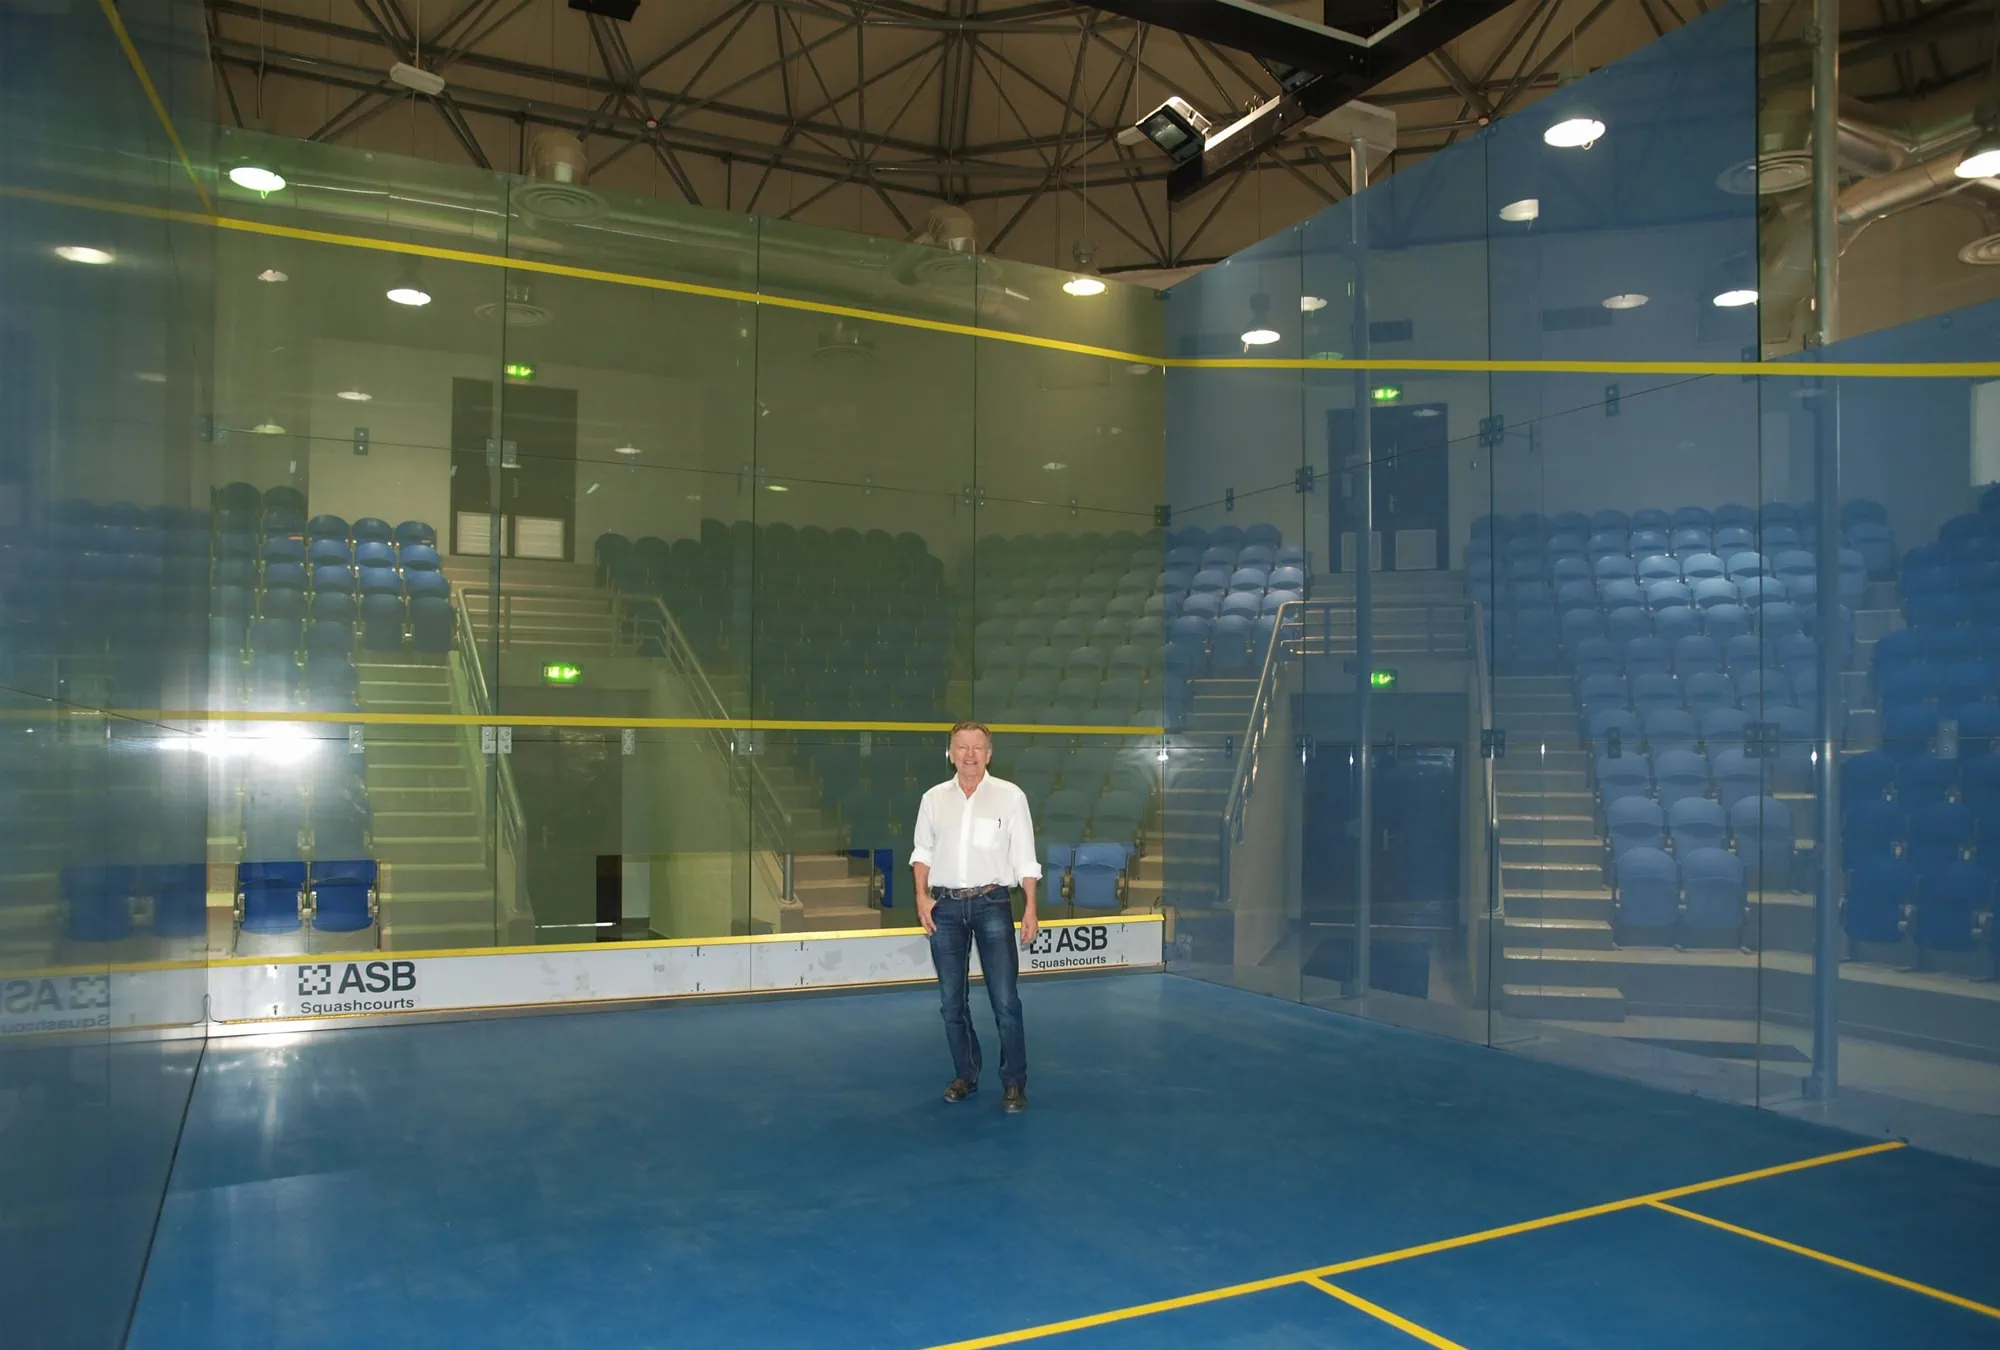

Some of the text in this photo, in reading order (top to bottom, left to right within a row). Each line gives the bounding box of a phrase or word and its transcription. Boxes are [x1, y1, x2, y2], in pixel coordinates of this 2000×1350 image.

[1056, 926, 1108, 953] ASB
[1031, 955, 1107, 970] Squashcourts
[338, 961, 416, 994] ASB
[300, 998, 415, 1015] Squashcourts
